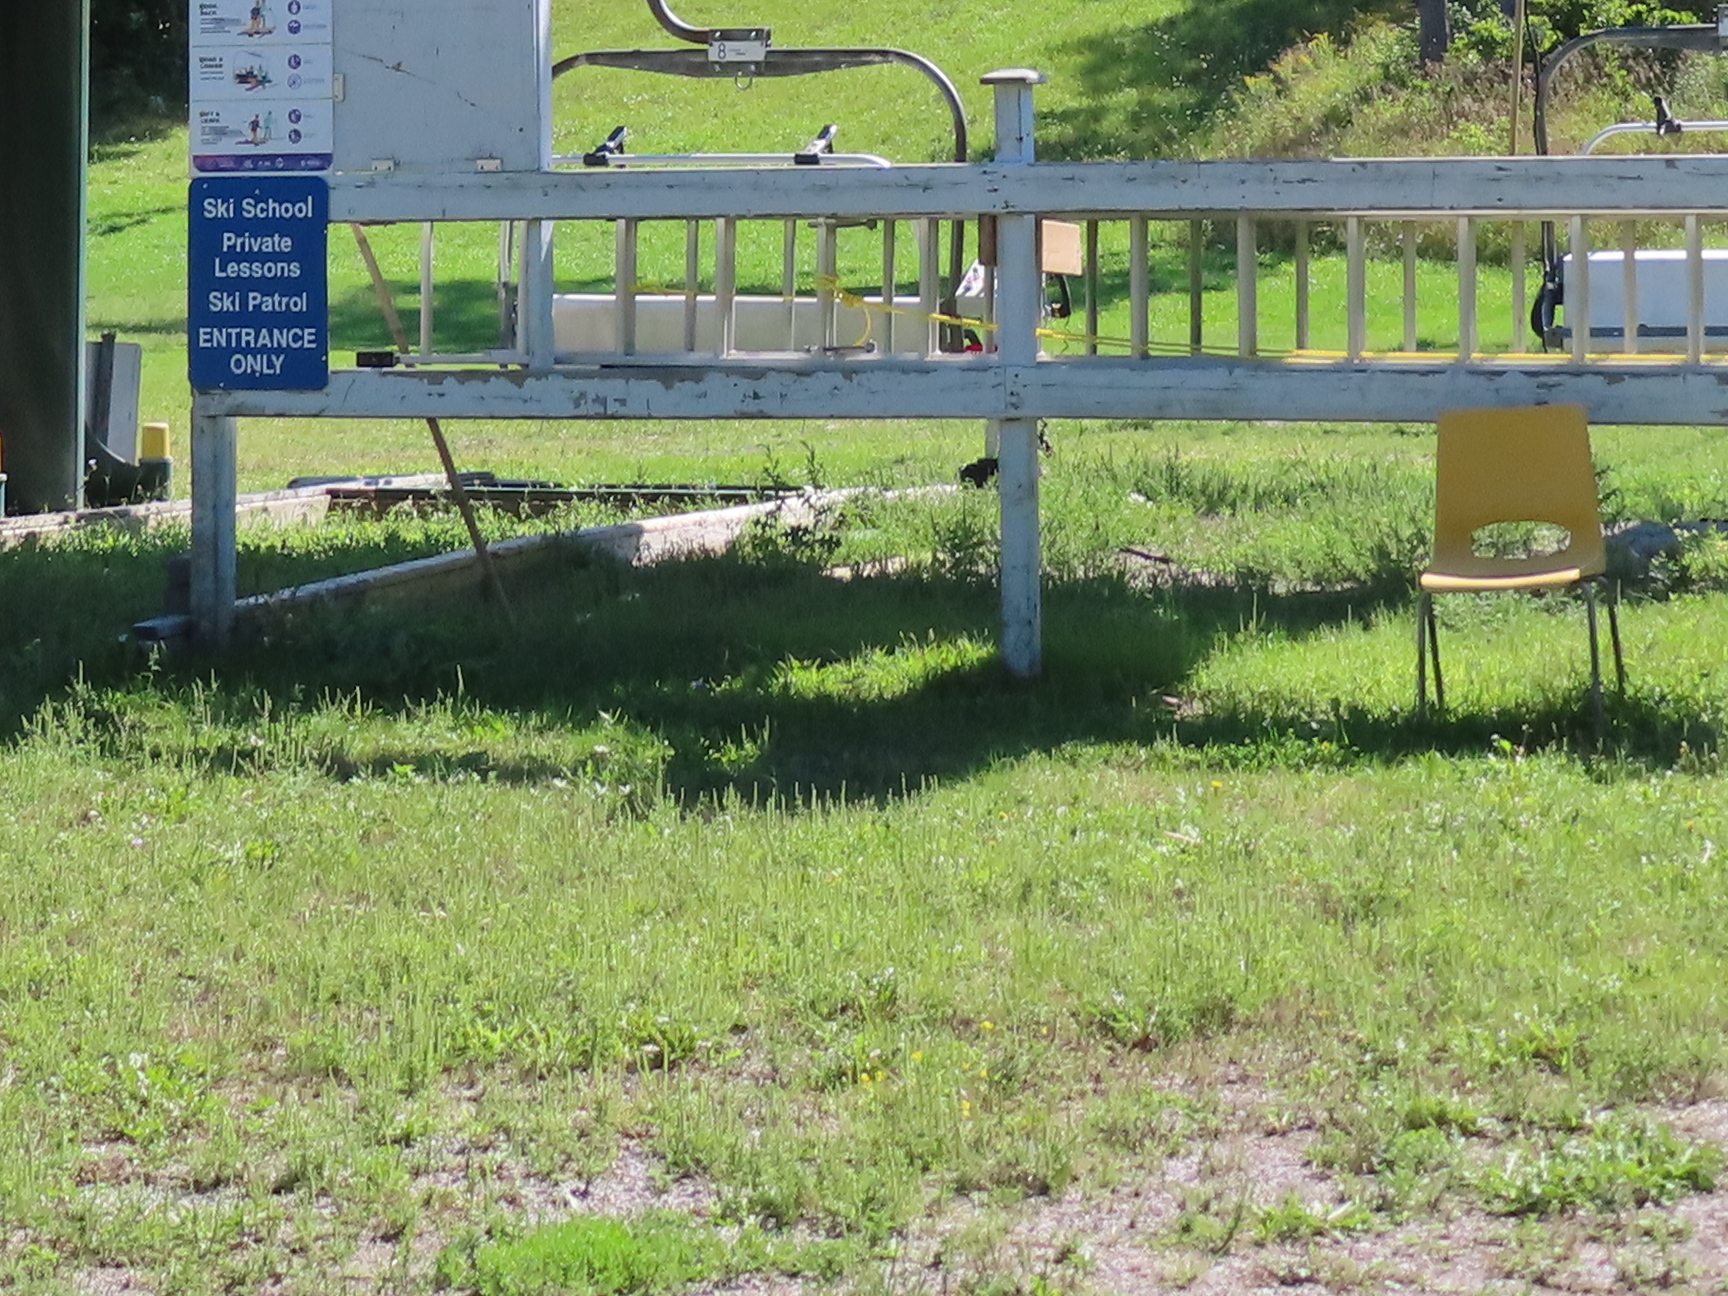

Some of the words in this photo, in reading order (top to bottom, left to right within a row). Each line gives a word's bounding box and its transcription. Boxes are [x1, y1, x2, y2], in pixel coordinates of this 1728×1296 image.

[718, 42, 726, 60] 8
[203, 198, 235, 219] Ski
[241, 196, 313, 219] School
[222, 232, 293, 253] Private
[214, 258, 301, 278] Lessons
[208, 292, 241, 312] Ski
[248, 292, 308, 312] Patrol
[198, 328, 317, 348] ENTRANCE
[230, 354, 286, 375] ONLY
